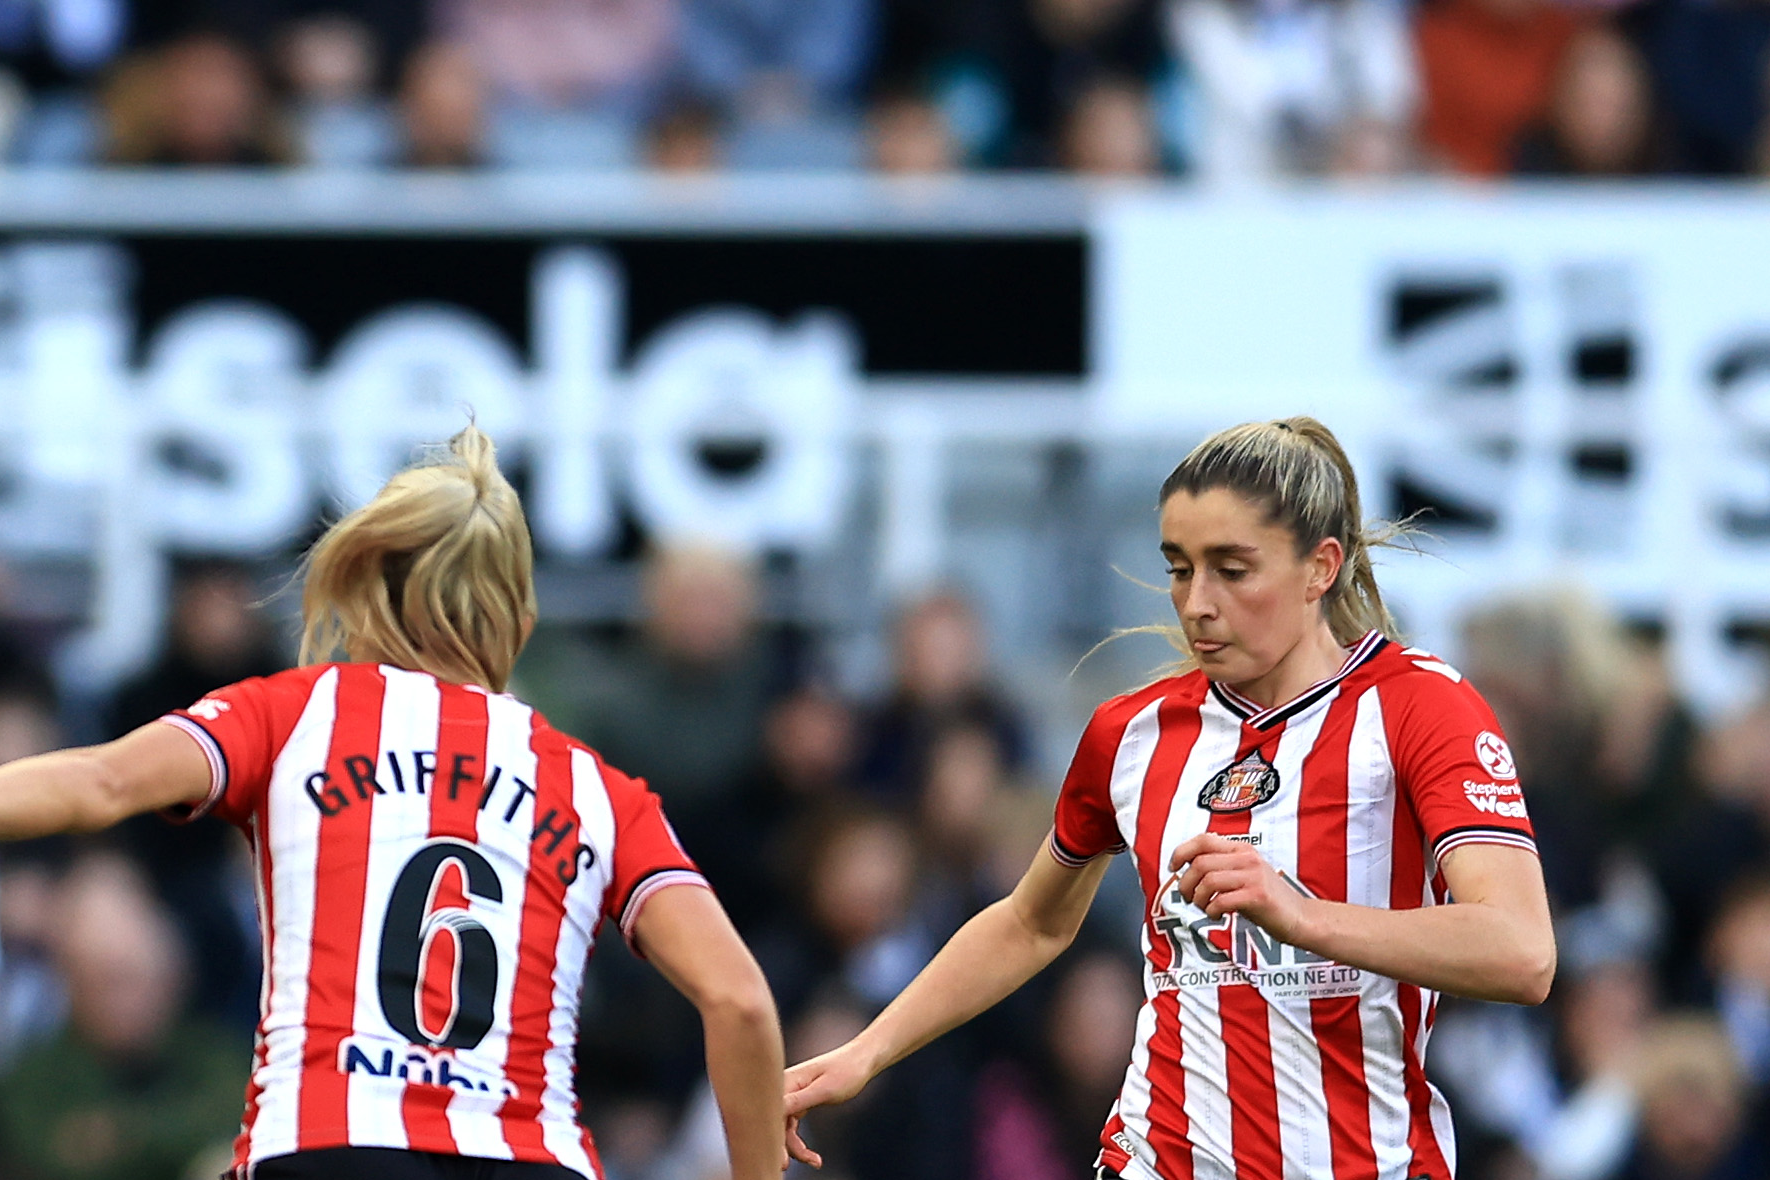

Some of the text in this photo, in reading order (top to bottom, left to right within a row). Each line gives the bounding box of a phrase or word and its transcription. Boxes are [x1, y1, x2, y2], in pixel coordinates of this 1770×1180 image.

[138, 243, 860, 556] sela
[304, 750, 595, 886] GRIFFITHS
[377, 836, 503, 1050] 6
[1304, 970, 1327, 984] NE
[1331, 968, 1360, 983] LTD
